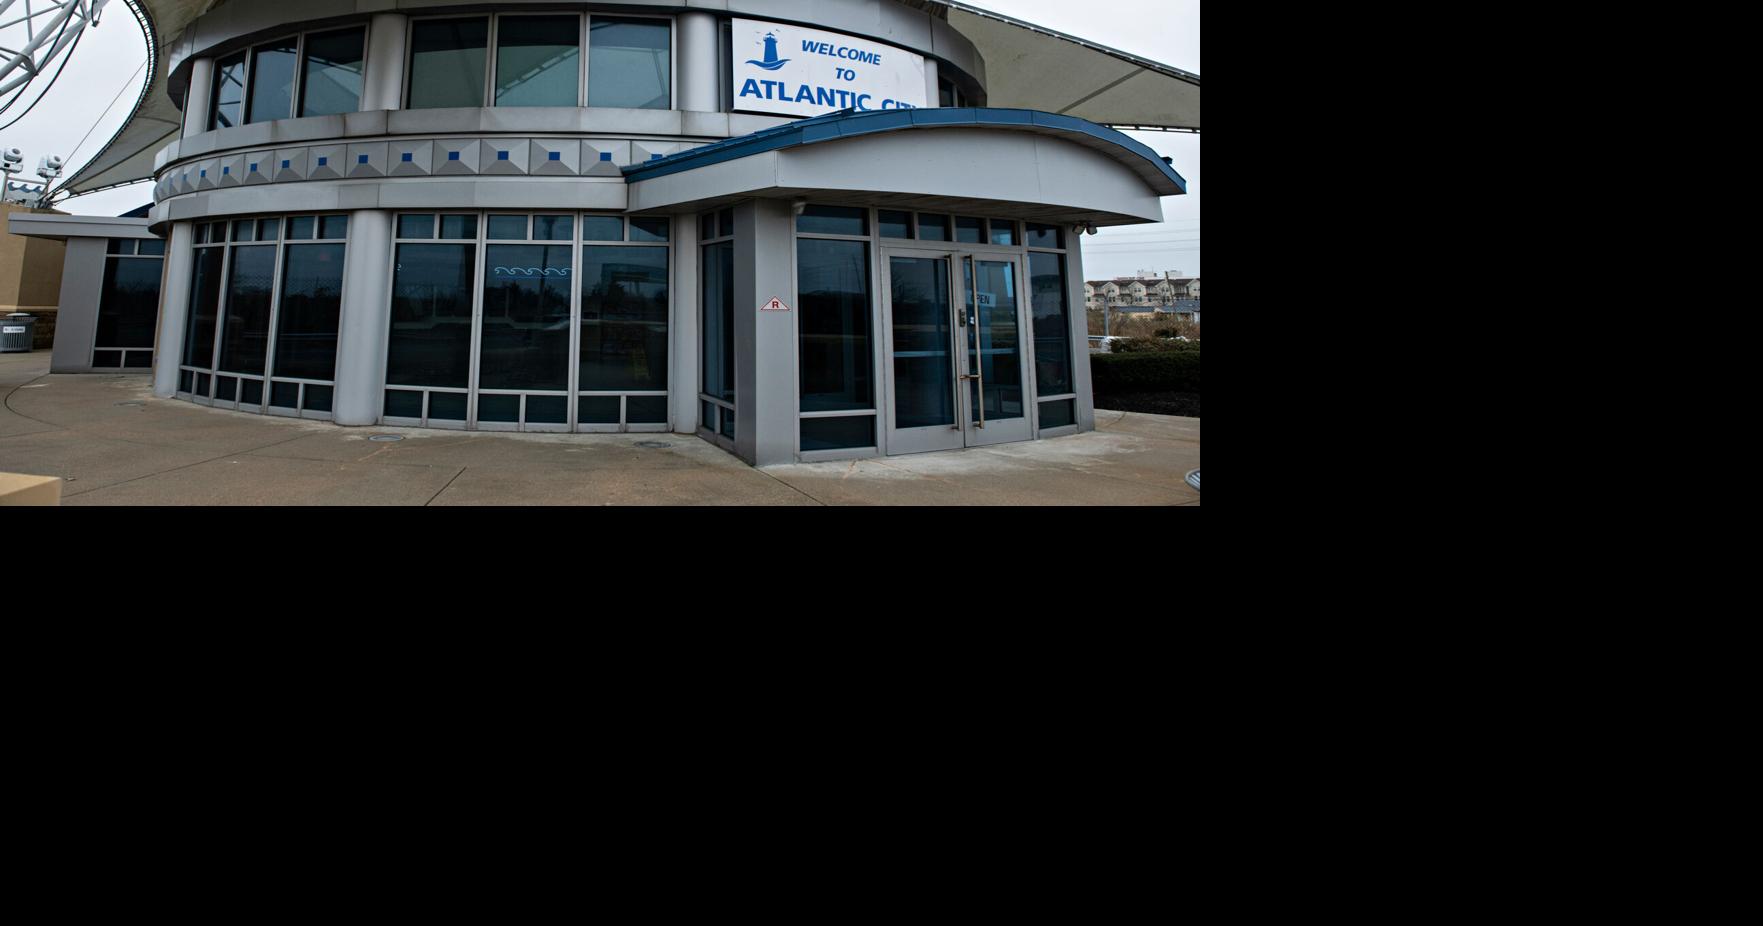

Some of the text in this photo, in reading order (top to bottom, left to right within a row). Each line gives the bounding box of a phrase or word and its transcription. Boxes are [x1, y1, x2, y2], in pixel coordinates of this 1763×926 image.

[801, 40, 882, 66] WELCOME
[835, 67, 856, 82] TO
[739, 79, 872, 112] ATLANTIC
[771, 301, 779, 309] R
